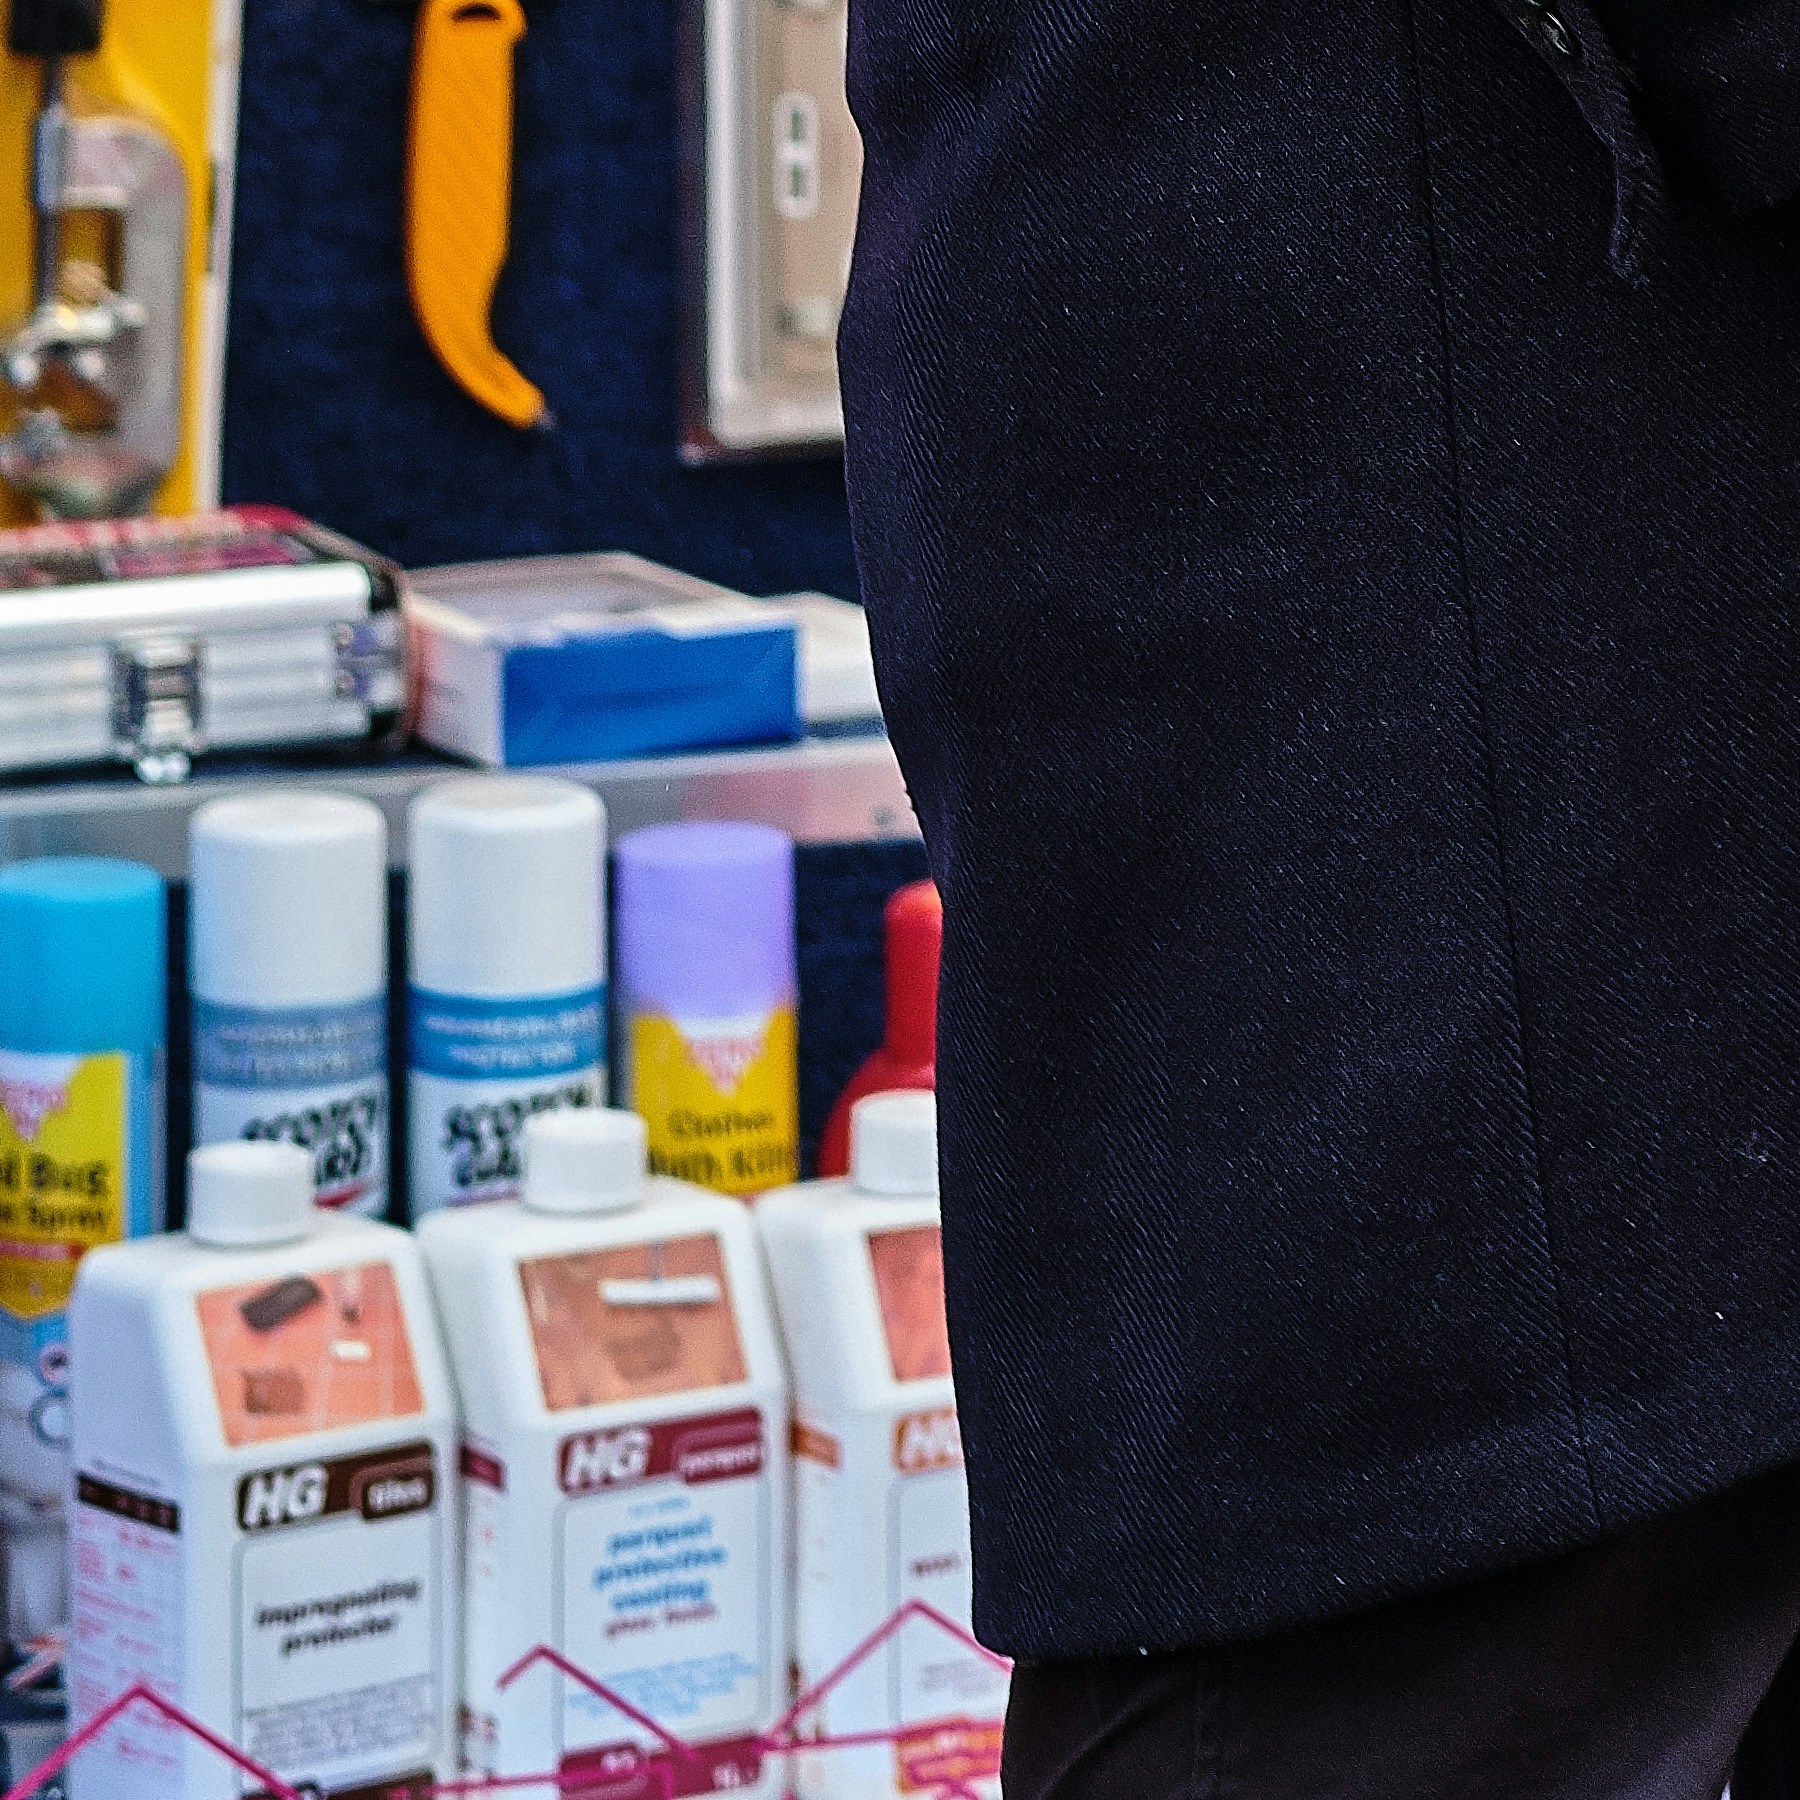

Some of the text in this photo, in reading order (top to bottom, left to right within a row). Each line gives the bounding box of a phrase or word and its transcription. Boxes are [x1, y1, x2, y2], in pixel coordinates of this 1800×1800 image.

[565, 1429, 652, 1488] HG
[243, 1465, 328, 1526] HG
[279, 1614, 398, 1658] protector
